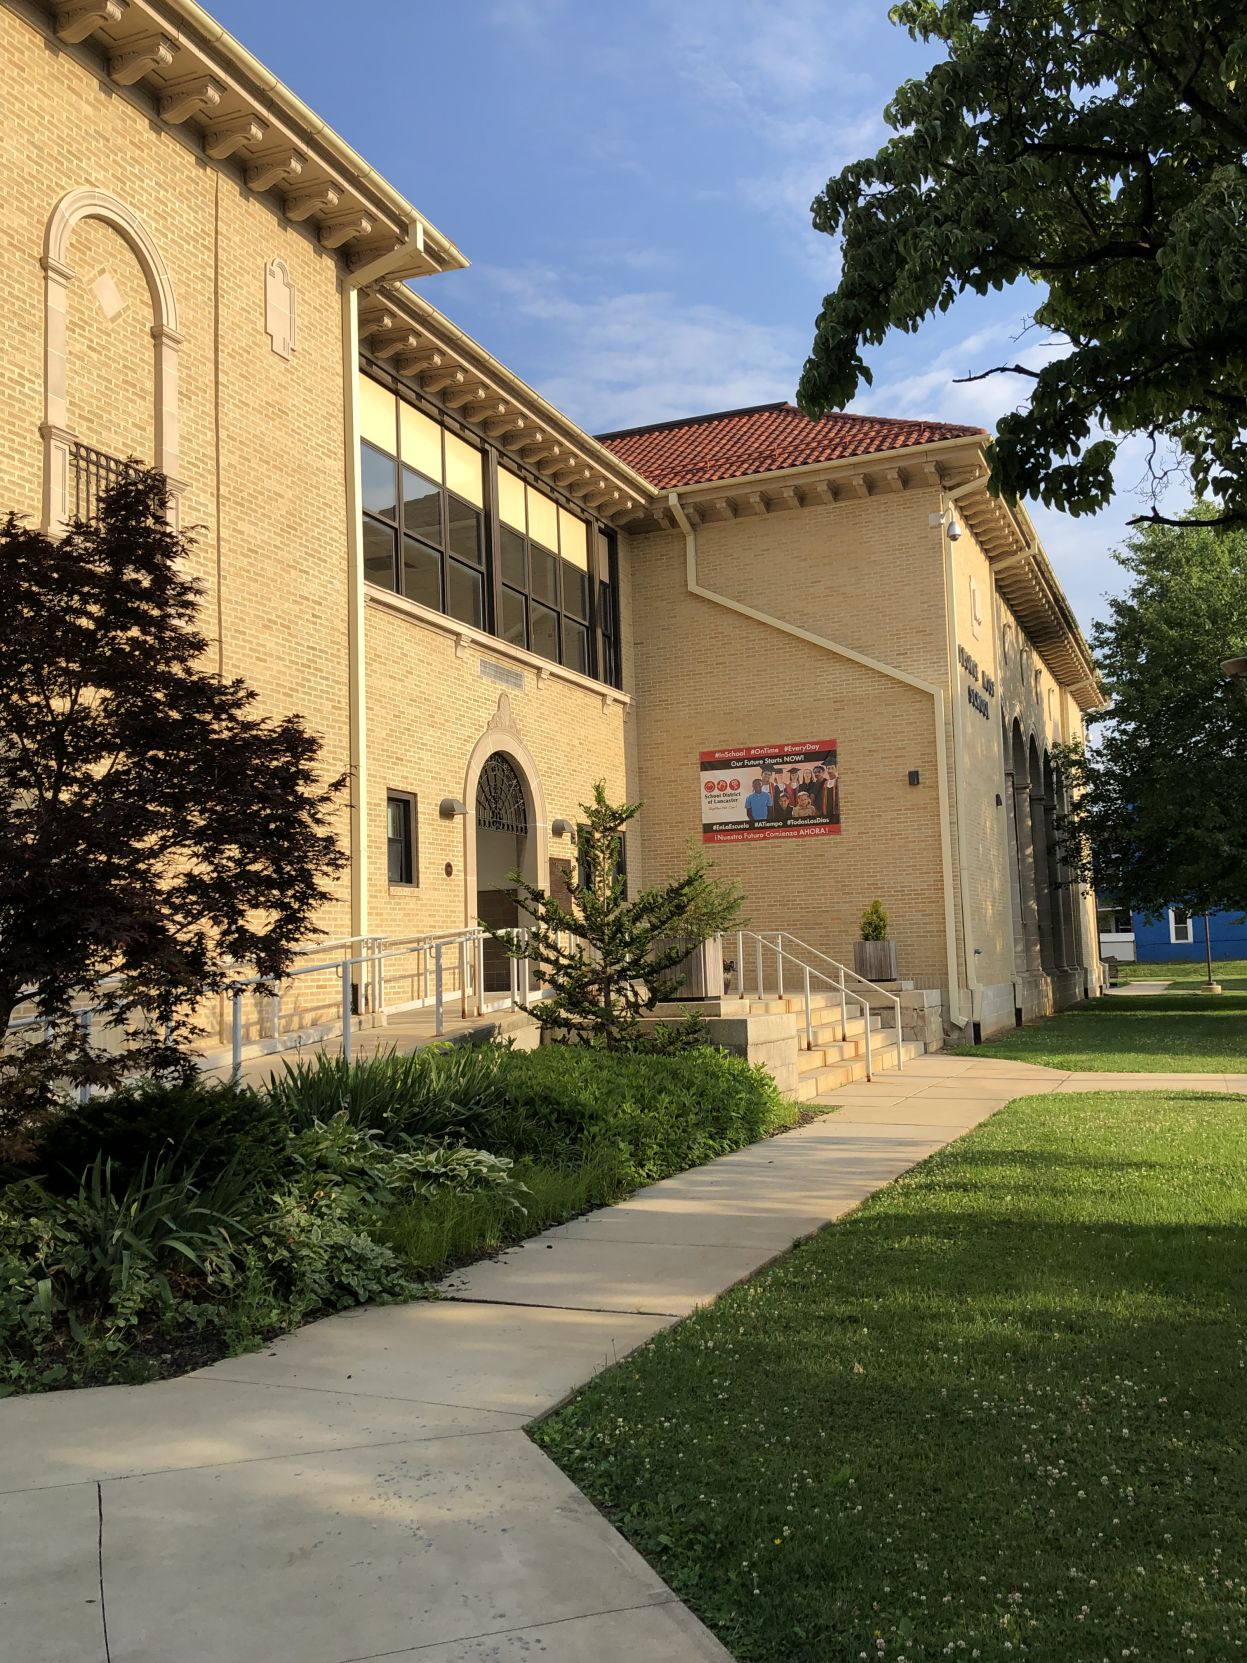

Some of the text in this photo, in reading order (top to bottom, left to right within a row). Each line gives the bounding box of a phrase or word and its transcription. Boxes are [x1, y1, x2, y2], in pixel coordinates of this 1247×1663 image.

[715, 743, 820, 759] #InSchool #OnTime #EveryDay
[744, 758, 763, 766] Future
[764, 756, 783, 764] Starts
[783, 754, 804, 763] NOW!
[712, 822, 750, 831] #EnLaEscuela
[754, 821, 783, 829] #ATiempo
[743, 831, 764, 839] Futuro
[765, 829, 798, 838] Comienza
